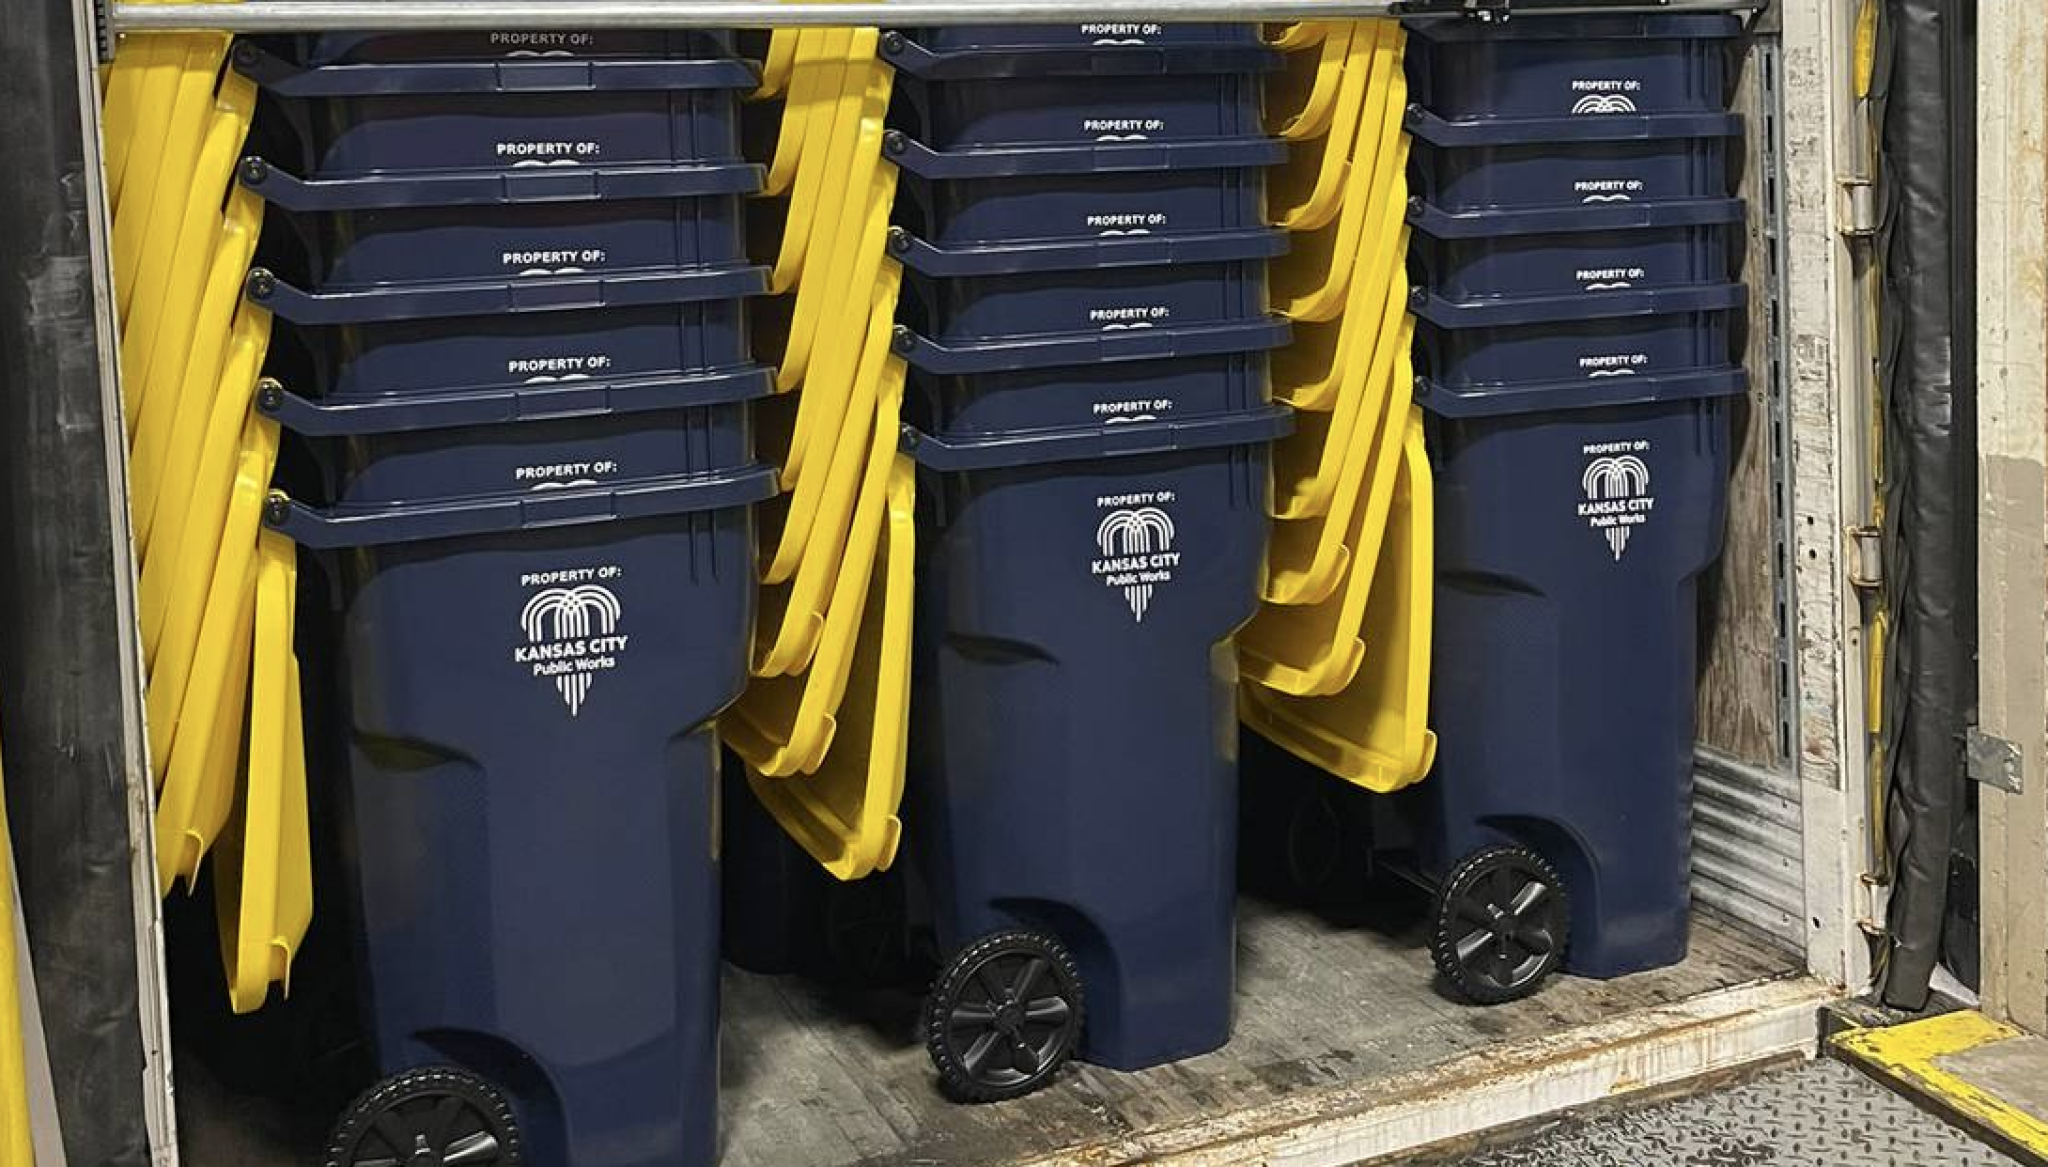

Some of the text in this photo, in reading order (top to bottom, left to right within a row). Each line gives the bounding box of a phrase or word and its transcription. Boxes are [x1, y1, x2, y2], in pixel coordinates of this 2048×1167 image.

[1082, 24, 1162, 34] PROPERTY OF:
[491, 33, 593, 45] PROPERTY OF:
[1573, 80, 1641, 91] PROPERTY OF:
[1084, 120, 1164, 130] PROPERTY OF:
[498, 143, 600, 155] PROPERTY OF:
[1575, 180, 1643, 191] PROPERTY OF:
[1088, 214, 1166, 225] PROPERTY OF:
[503, 250, 606, 263] PROPERTY OF:
[1577, 268, 1645, 280] PROPERTY OF:
[1090, 308, 1170, 320] PROPERTY OF:
[509, 357, 611, 372] PROPERTY OF:
[1580, 354, 1648, 367] PROPERTY OF:
[1094, 400, 1173, 413] PROPERTY OF:
[1584, 440, 1650, 454] PROPERTY OF:
[516, 461, 617, 479] PROPERTY OF:
[1097, 492, 1175, 507] PROPERTY OF:
[1578, 498, 1654, 515] KANSAS CITY
[1590, 513, 1645, 527] Public Works
[1092, 552, 1180, 574] KANSAS CITY
[522, 567, 623, 586] PROPERTY OF:
[1106, 570, 1171, 586] Public Works
[515, 636, 628, 662] KANSAS CITY
[533, 656, 615, 676] Public Works
